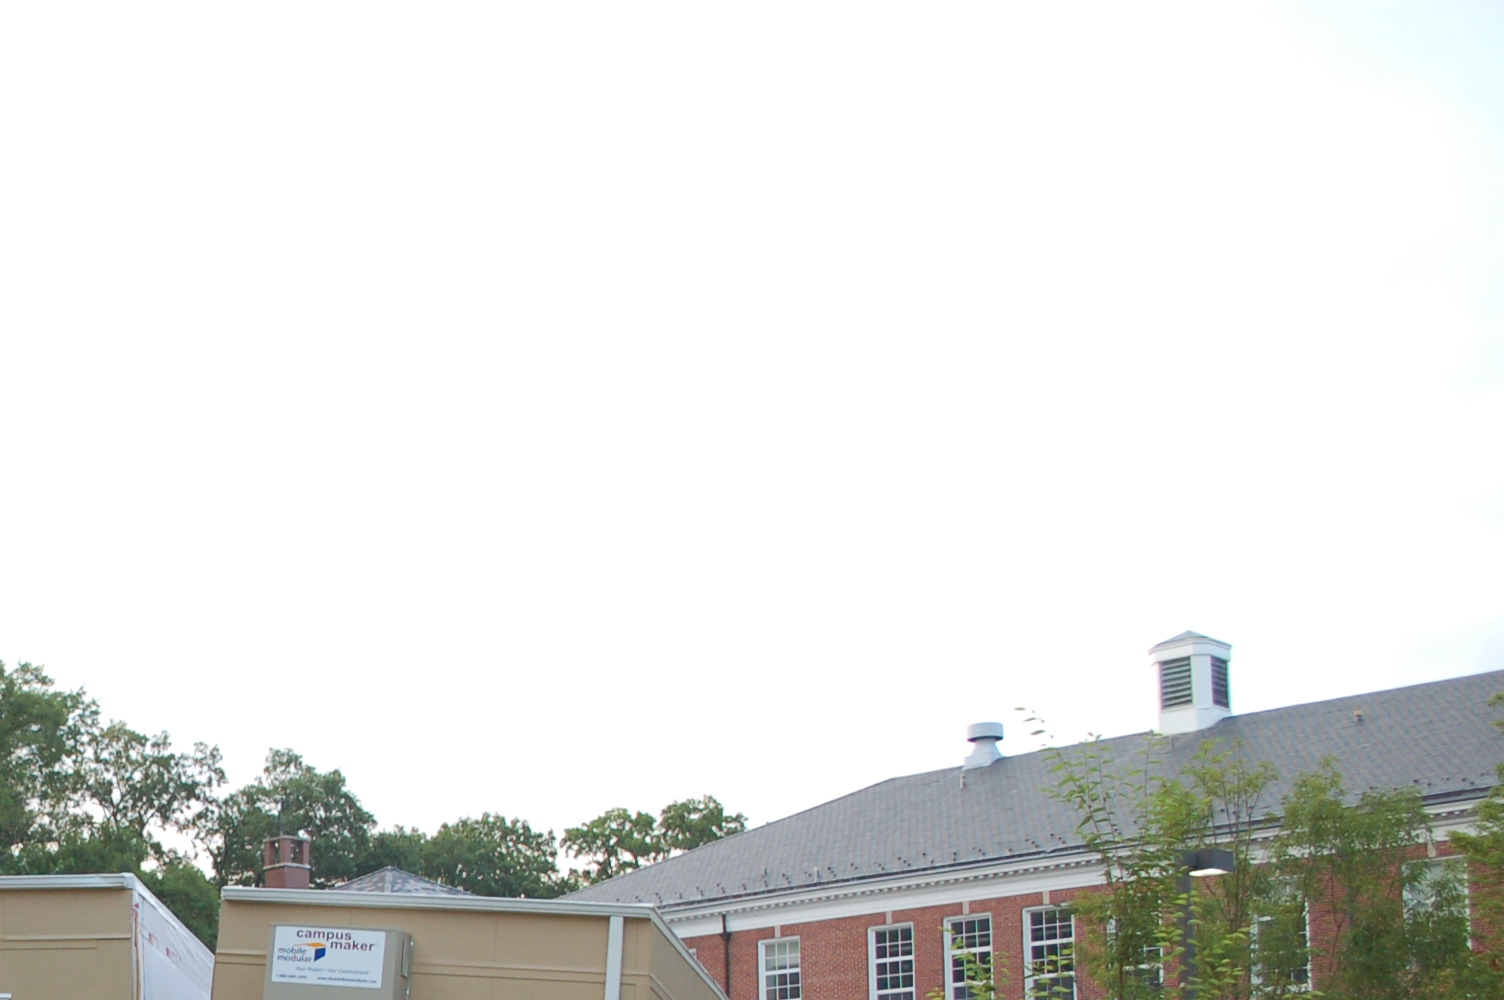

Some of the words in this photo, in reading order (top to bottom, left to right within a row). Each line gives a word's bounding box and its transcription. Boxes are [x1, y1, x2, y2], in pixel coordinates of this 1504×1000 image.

[296, 929, 352, 942] campus
[277, 946, 306, 955] mobile
[330, 940, 375, 952] maker
[277, 954, 312, 963] modular
